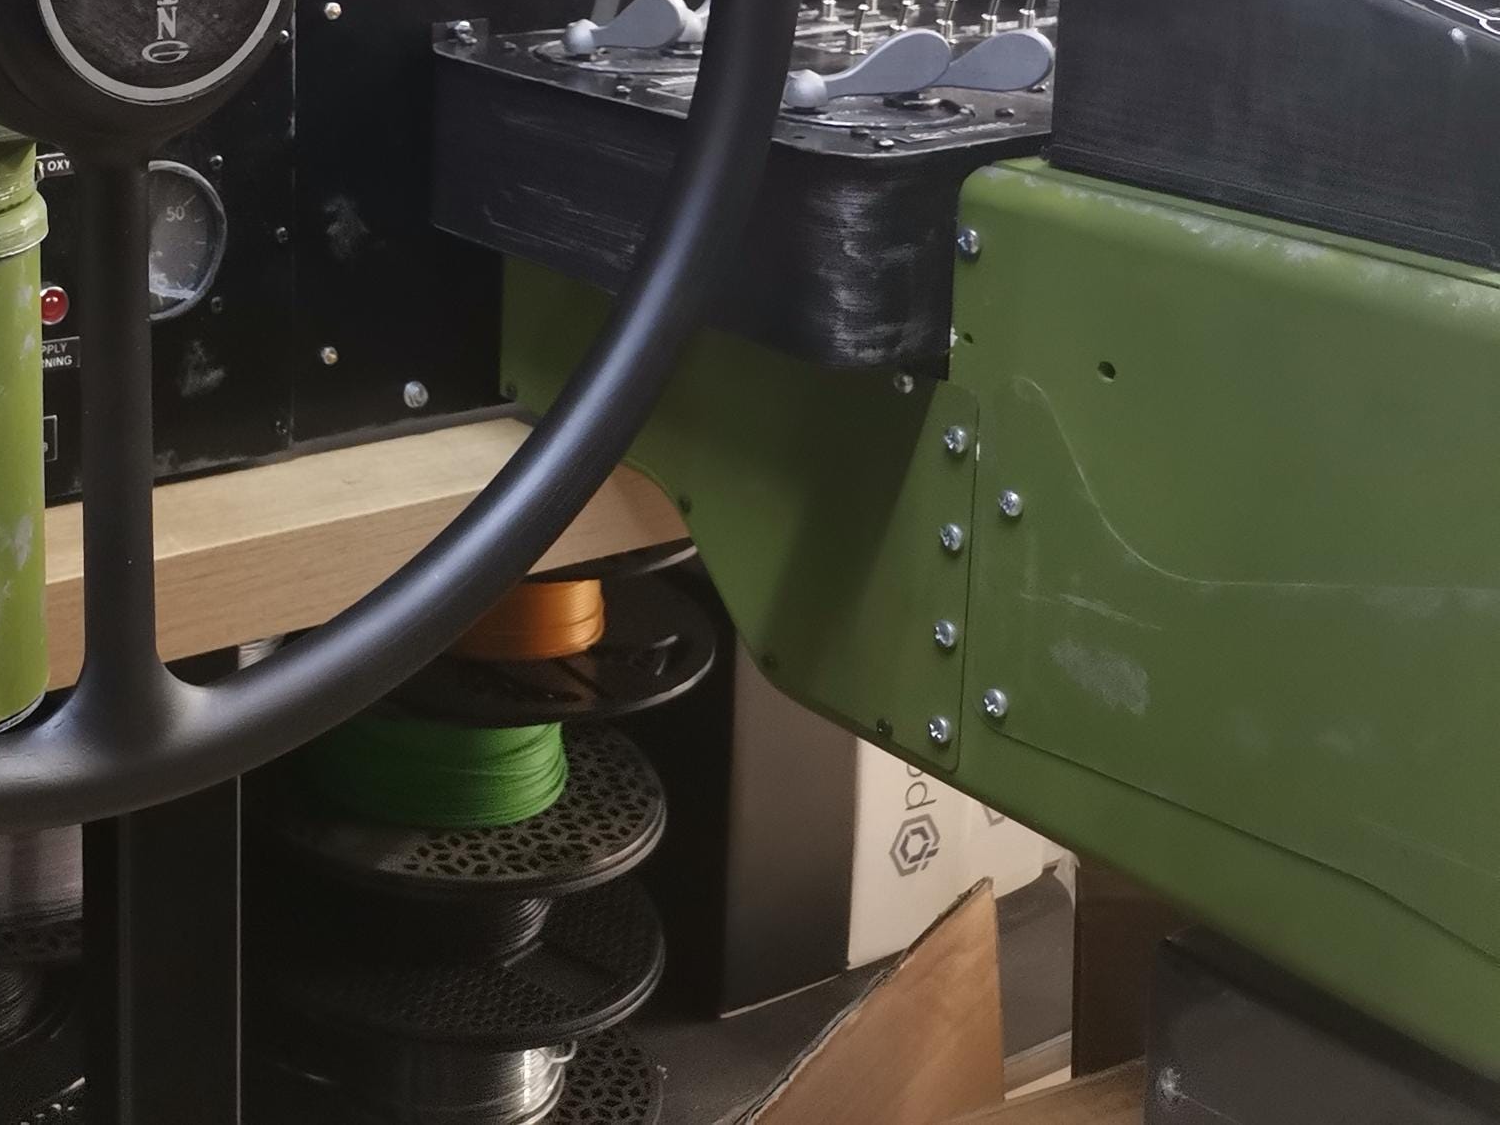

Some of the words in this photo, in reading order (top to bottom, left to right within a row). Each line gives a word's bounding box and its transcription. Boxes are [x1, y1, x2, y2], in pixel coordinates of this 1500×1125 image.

[48, 159, 70, 171] OXY
[166, 206, 185, 221] 50
[42, 343, 67, 355] PPLY
[42, 355, 72, 368] NING
